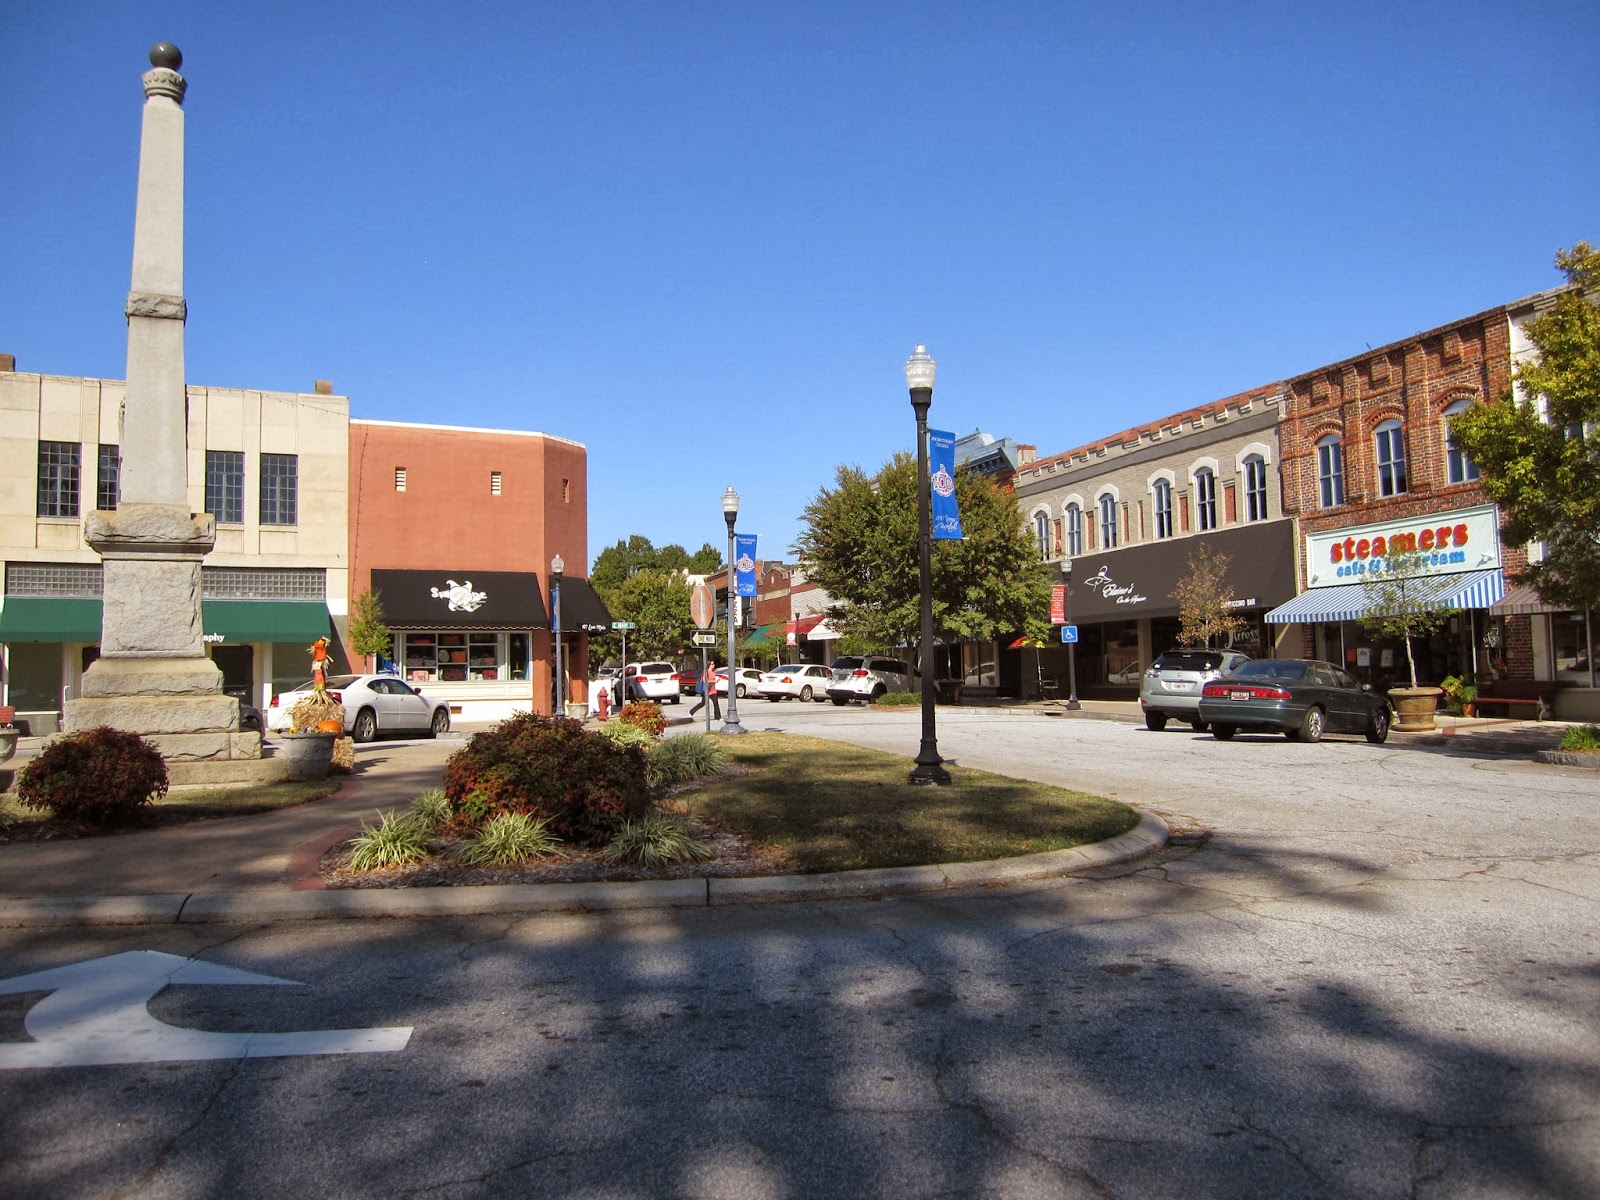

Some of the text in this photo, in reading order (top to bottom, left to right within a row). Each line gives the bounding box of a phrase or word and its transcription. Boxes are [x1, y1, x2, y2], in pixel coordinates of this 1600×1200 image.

[1330, 523, 1469, 564] steamers
[1336, 560, 1366, 577] cafe
[1247, 598, 1256, 606] BAR
